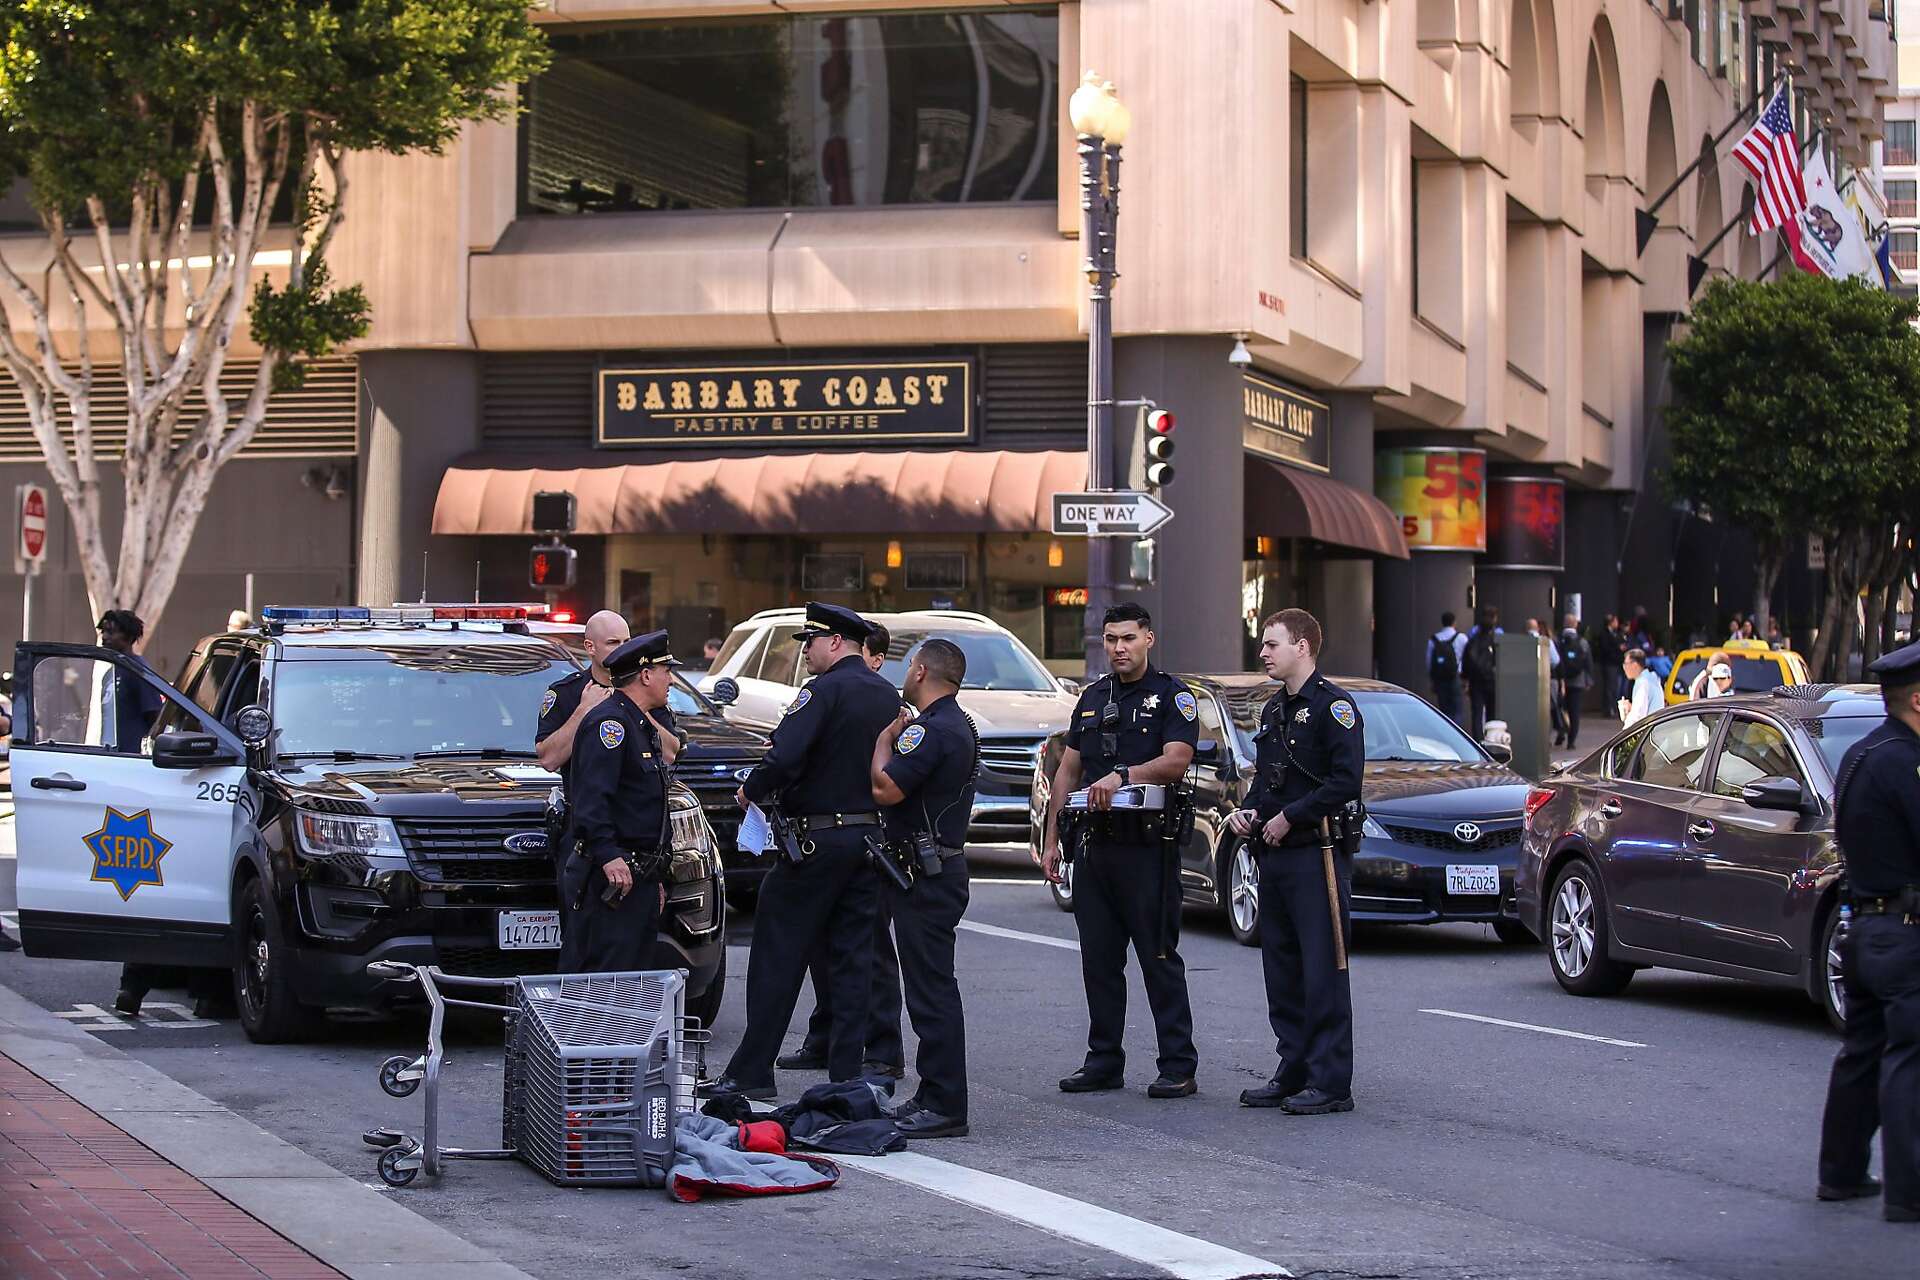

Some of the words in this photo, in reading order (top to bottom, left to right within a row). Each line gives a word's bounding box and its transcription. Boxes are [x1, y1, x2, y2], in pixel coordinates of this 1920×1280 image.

[616, 378, 802, 411] BARBARY
[822, 374, 949, 407] COAST
[674, 417, 758, 432] PASTRY
[772, 416, 784, 430] &
[797, 415, 879, 430] COFFEE
[1066, 507, 1097, 520] ONE
[1103, 507, 1135, 520] WAY
[1450, 876, 1496, 890] 7RLZ025
[504, 925, 559, 943] 147217
[658, 1097, 666, 1112] BED
[658, 1113, 666, 1132] BATH
